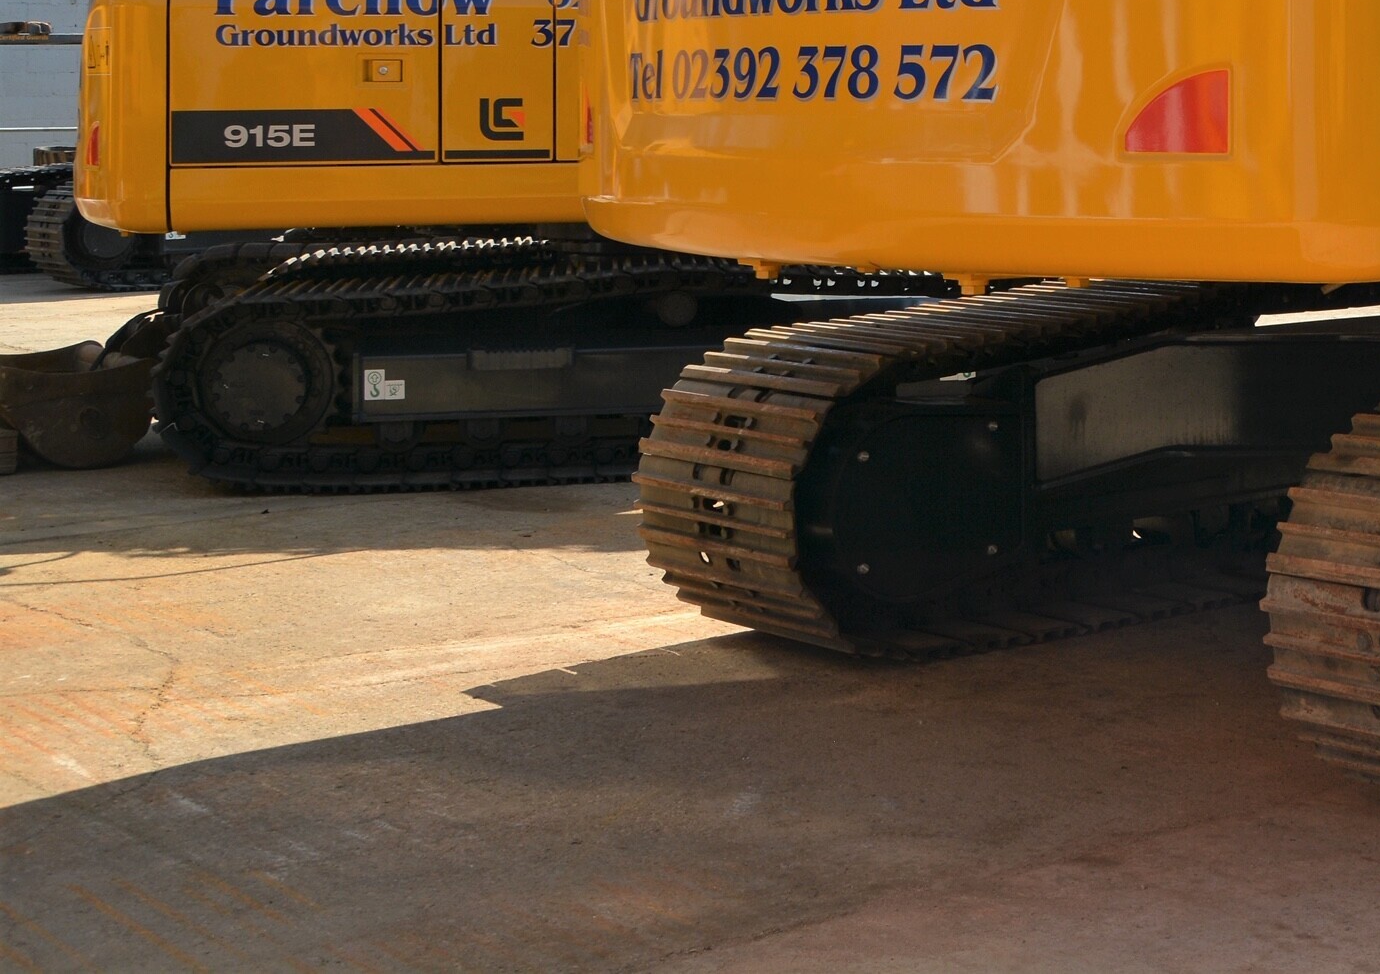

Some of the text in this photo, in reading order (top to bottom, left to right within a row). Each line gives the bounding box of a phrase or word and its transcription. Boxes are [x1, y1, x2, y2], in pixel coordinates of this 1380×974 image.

[215, 23, 498, 47] Groundworks Ltd
[630, 43, 1000, 102] Tel 02392 378 572
[224, 124, 316, 148] 915E
